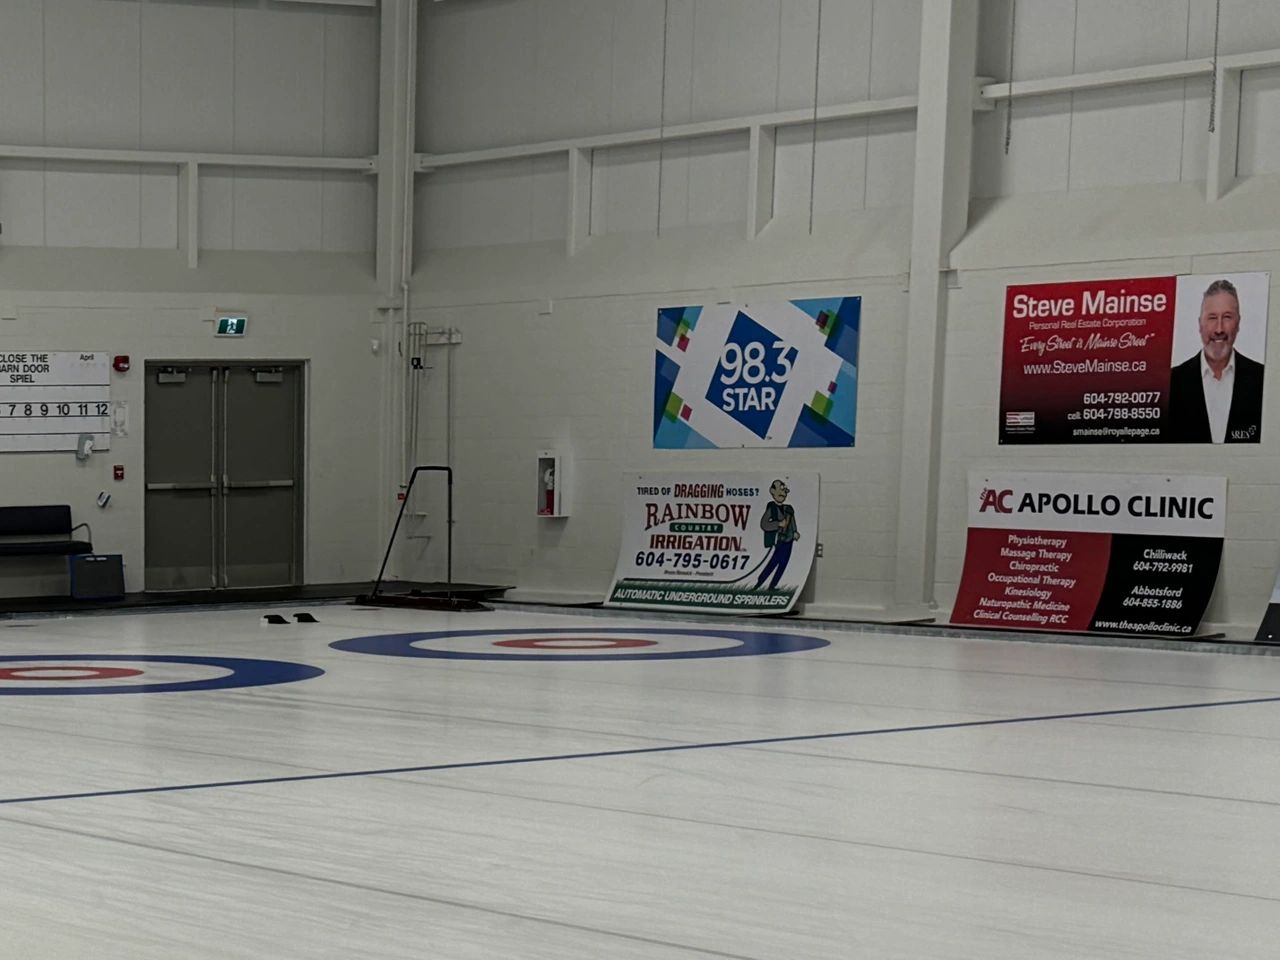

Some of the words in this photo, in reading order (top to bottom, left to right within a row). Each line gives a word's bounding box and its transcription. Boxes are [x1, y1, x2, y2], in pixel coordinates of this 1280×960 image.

[1013, 294, 1074, 318] Steve
[1082, 289, 1167, 315] Mainse
[1029, 320, 1059, 330] Personal
[1061, 320, 1077, 329] Real
[1078, 319, 1101, 328] Estate
[1103, 318, 1146, 328] Corporation
[1046, 334, 1076, 351] Street
[1084, 333, 1117, 350] Mainse
[31, 354, 48, 363] THE
[720, 340, 794, 385] 98.3
[23, 364, 50, 373] DOOR
[1023, 359, 1147, 375] www.SteveMainse.ca
[9, 374, 35, 383] SPIEL
[722, 387, 776, 412] STAR
[1083, 392, 1160, 404] 604-792-0077
[8, 404, 16, 416] 7
[24, 404, 32, 416] 8
[40, 404, 48, 416] 9
[56, 404, 70, 415] 10
[78, 404, 88, 415] 11
[96, 404, 108, 415] 12
[1083, 407, 1160, 419] 604-798-8550
[636, 487, 659, 495] TIRED
[661, 487, 671, 495] OF
[674, 484, 724, 498] DRAGGING
[726, 488, 759, 496] HOSES?
[979, 489, 1013, 513] AC
[1017, 492, 1120, 517] APOLLO
[1127, 495, 1214, 520] CLINIC
[645, 503, 751, 531] RAINBOW
[650, 534, 741, 551] IRRIGATION
[1008, 534, 1067, 548] Physiotherapy
[635, 551, 750, 570] 604-795-0617
[1001, 548, 1036, 560] Massage
[1038, 549, 1072, 562] Therapy
[1143, 549, 1187, 560] Chilliwack
[1009, 561, 1059, 573] Chiropractic
[1133, 561, 1193, 573] 604-792-9981
[988, 572, 1040, 584] Occupational
[1043, 576, 1076, 588] Therapy
[614, 588, 664, 600] AUTOMATIC
[664, 591, 732, 603] UNDERGROUND
[733, 594, 789, 605] SPRINKLERS
[1005, 586, 1052, 600] Kinesiology
[1131, 585, 1183, 597] Abbotsford
[979, 597, 1031, 609] Naturopathic
[1032, 601, 1070, 611] Medicine
[973, 609, 1001, 619] Clinical
[1002, 611, 1048, 624] Counselling
[1049, 614, 1069, 623] RCC
[1095, 620, 1192, 633] www.theapolloclinic.ca
